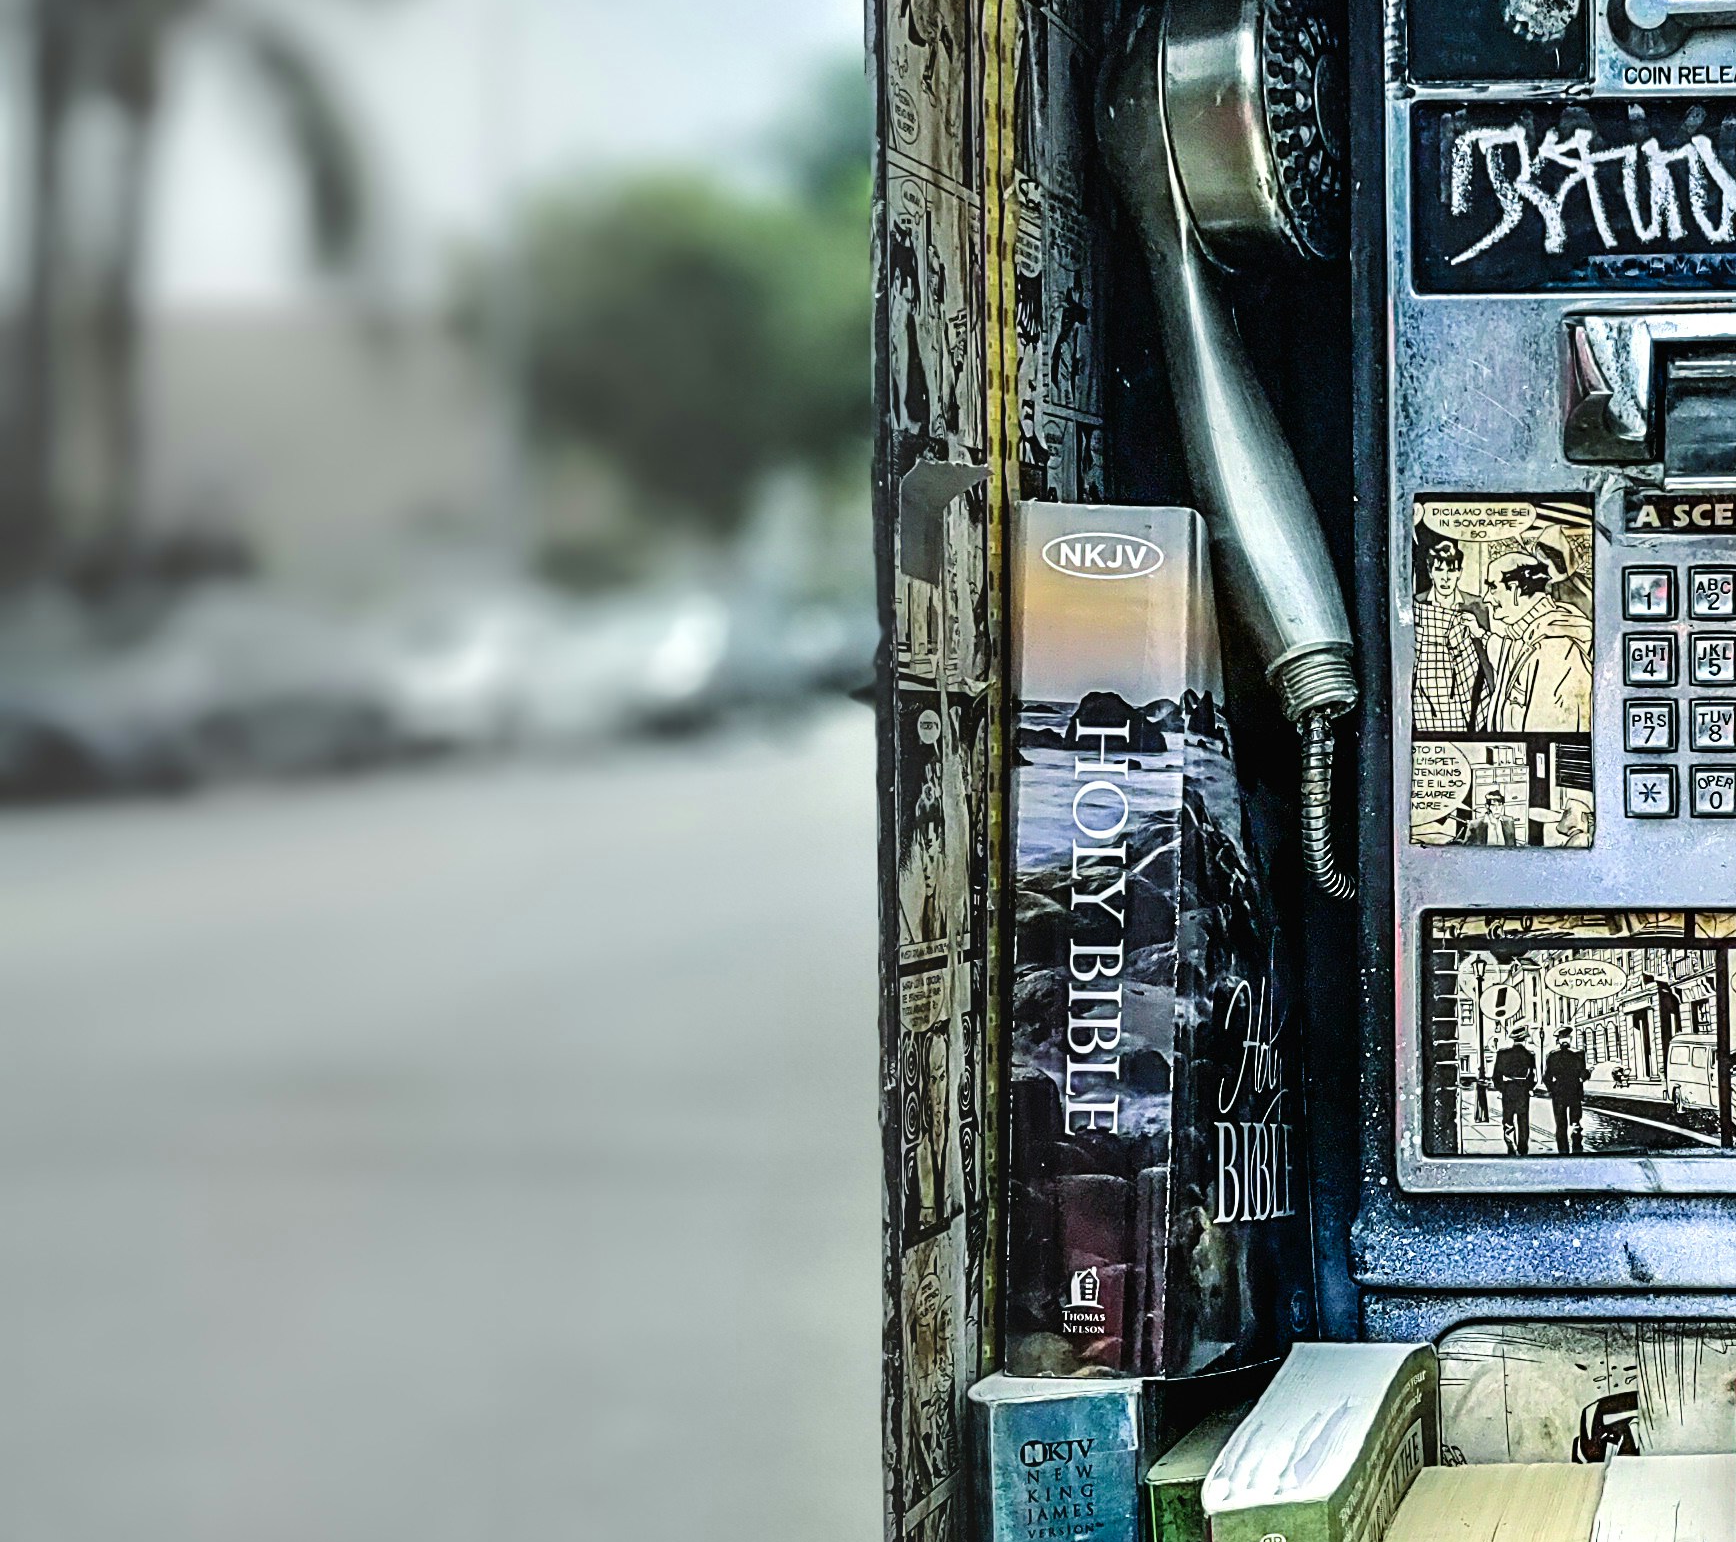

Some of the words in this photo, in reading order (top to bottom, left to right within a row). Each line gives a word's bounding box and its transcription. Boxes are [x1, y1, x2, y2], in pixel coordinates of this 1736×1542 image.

[1624, 66, 1673, 86] COIN
[1432, 508, 1481, 516] DICIAMO
[1486, 508, 1508, 516] CHE
[1512, 508, 1530, 516] SEI
[1634, 504, 1659, 527] A
[1059, 543, 1147, 568] NKJV
[1696, 579, 1731, 594] ABC
[1643, 592, 1652, 610] 1
[1707, 593, 1720, 610] 2
[1632, 645, 1666, 661] GHI
[1698, 644, 1731, 660] JKL
[1643, 659, 1656, 676] 4
[1709, 658, 1721, 675] 5
[1632, 712, 1666, 727] PRS
[1700, 711, 1732, 725] TUV
[1643, 726, 1655, 743] 7
[1709, 725, 1721, 742] 8
[1698, 775, 1733, 789] OPER
[1709, 791, 1723, 809] 0
[1071, 719, 1131, 927] HOLY
[1558, 968, 1607, 976] GUARDA
[1065, 938, 1124, 1136] BIBLE
[1213, 1122, 1295, 1224] BIBLE
[1062, 1311, 1105, 1321] THOMAS
[1062, 1323, 1104, 1334] NELSON
[1020, 1439, 1095, 1467] NKJV
[1401, 1431, 1420, 1477] THE
[1028, 1465, 1092, 1483] NEW
[1028, 1484, 1093, 1503] KING
[1028, 1502, 1093, 1525] JAMES
